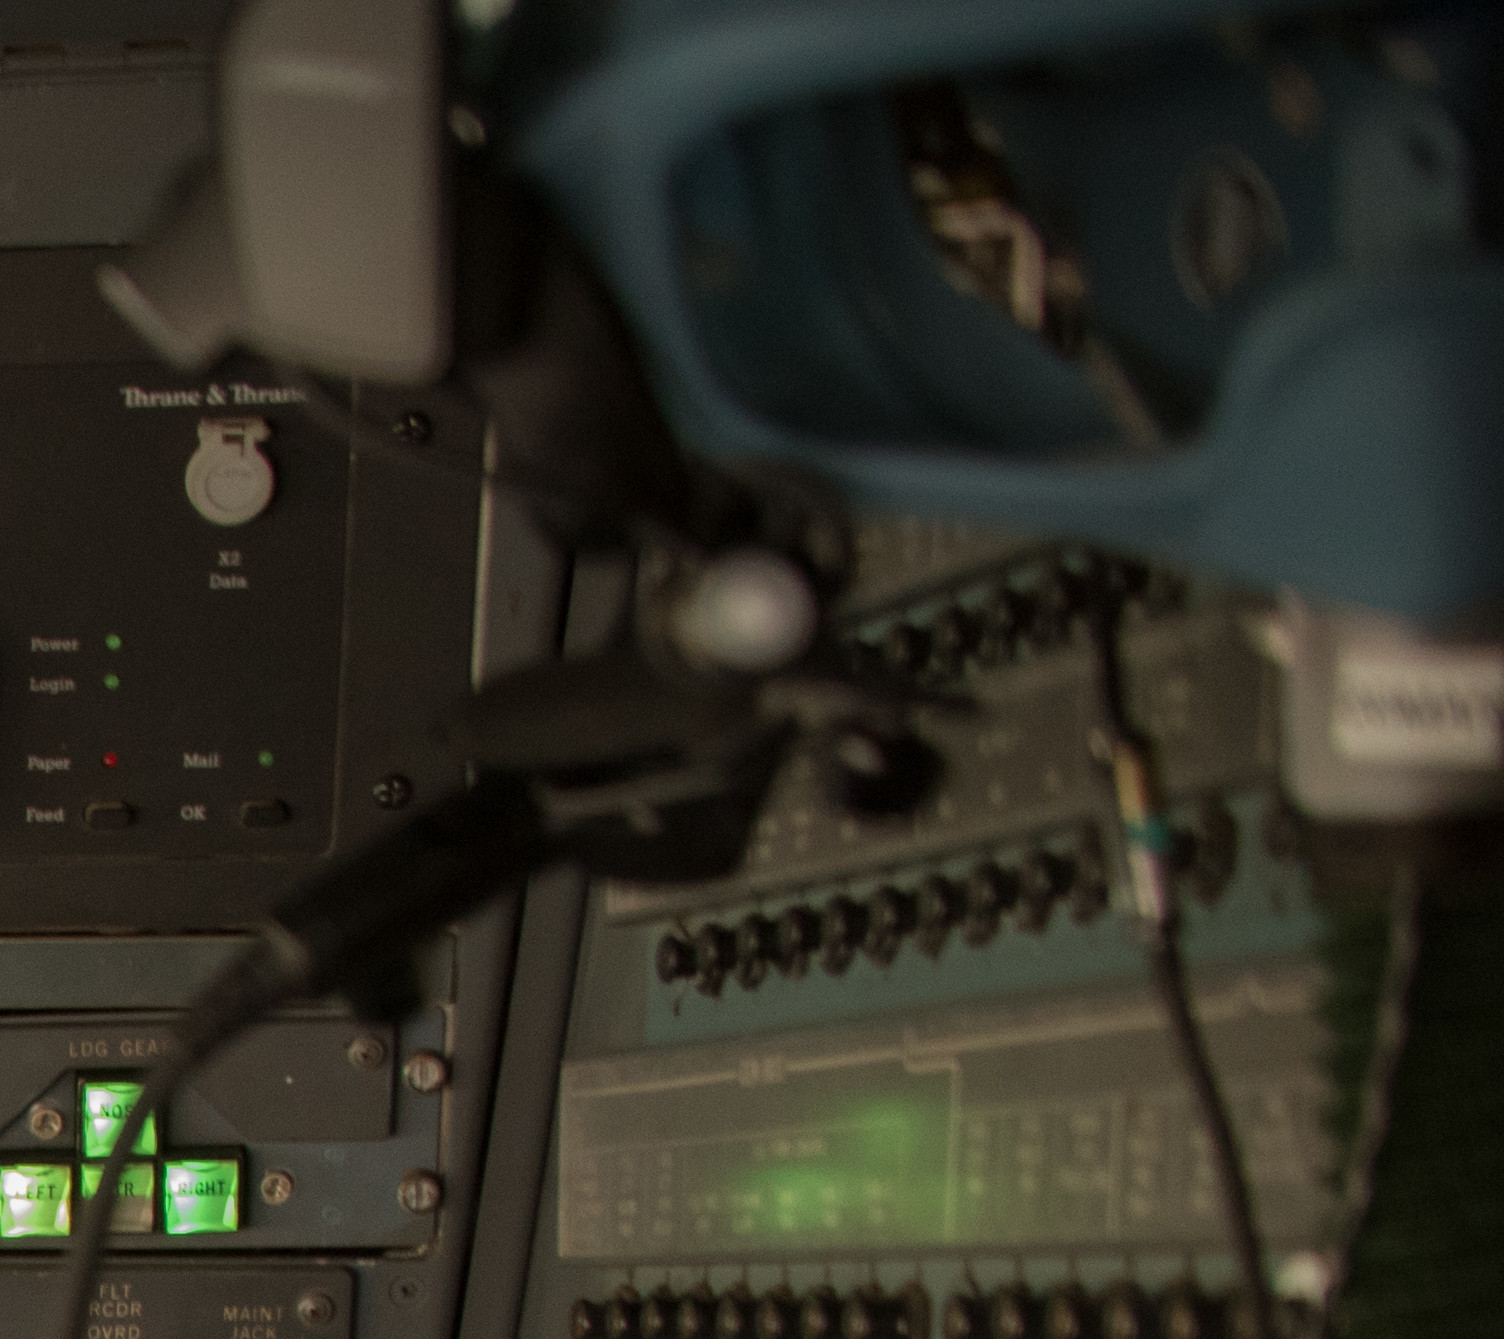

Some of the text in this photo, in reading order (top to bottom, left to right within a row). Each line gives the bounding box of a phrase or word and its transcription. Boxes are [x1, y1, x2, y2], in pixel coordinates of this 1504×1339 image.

[121, 386, 200, 408] Thrane
[208, 572, 248, 590] Data
[30, 636, 79, 653] Power
[29, 675, 75, 694] Login
[27, 754, 71, 773] Paper
[182, 751, 220, 768] Mail
[25, 806, 65, 823] Feed
[180, 804, 206, 820] OK
